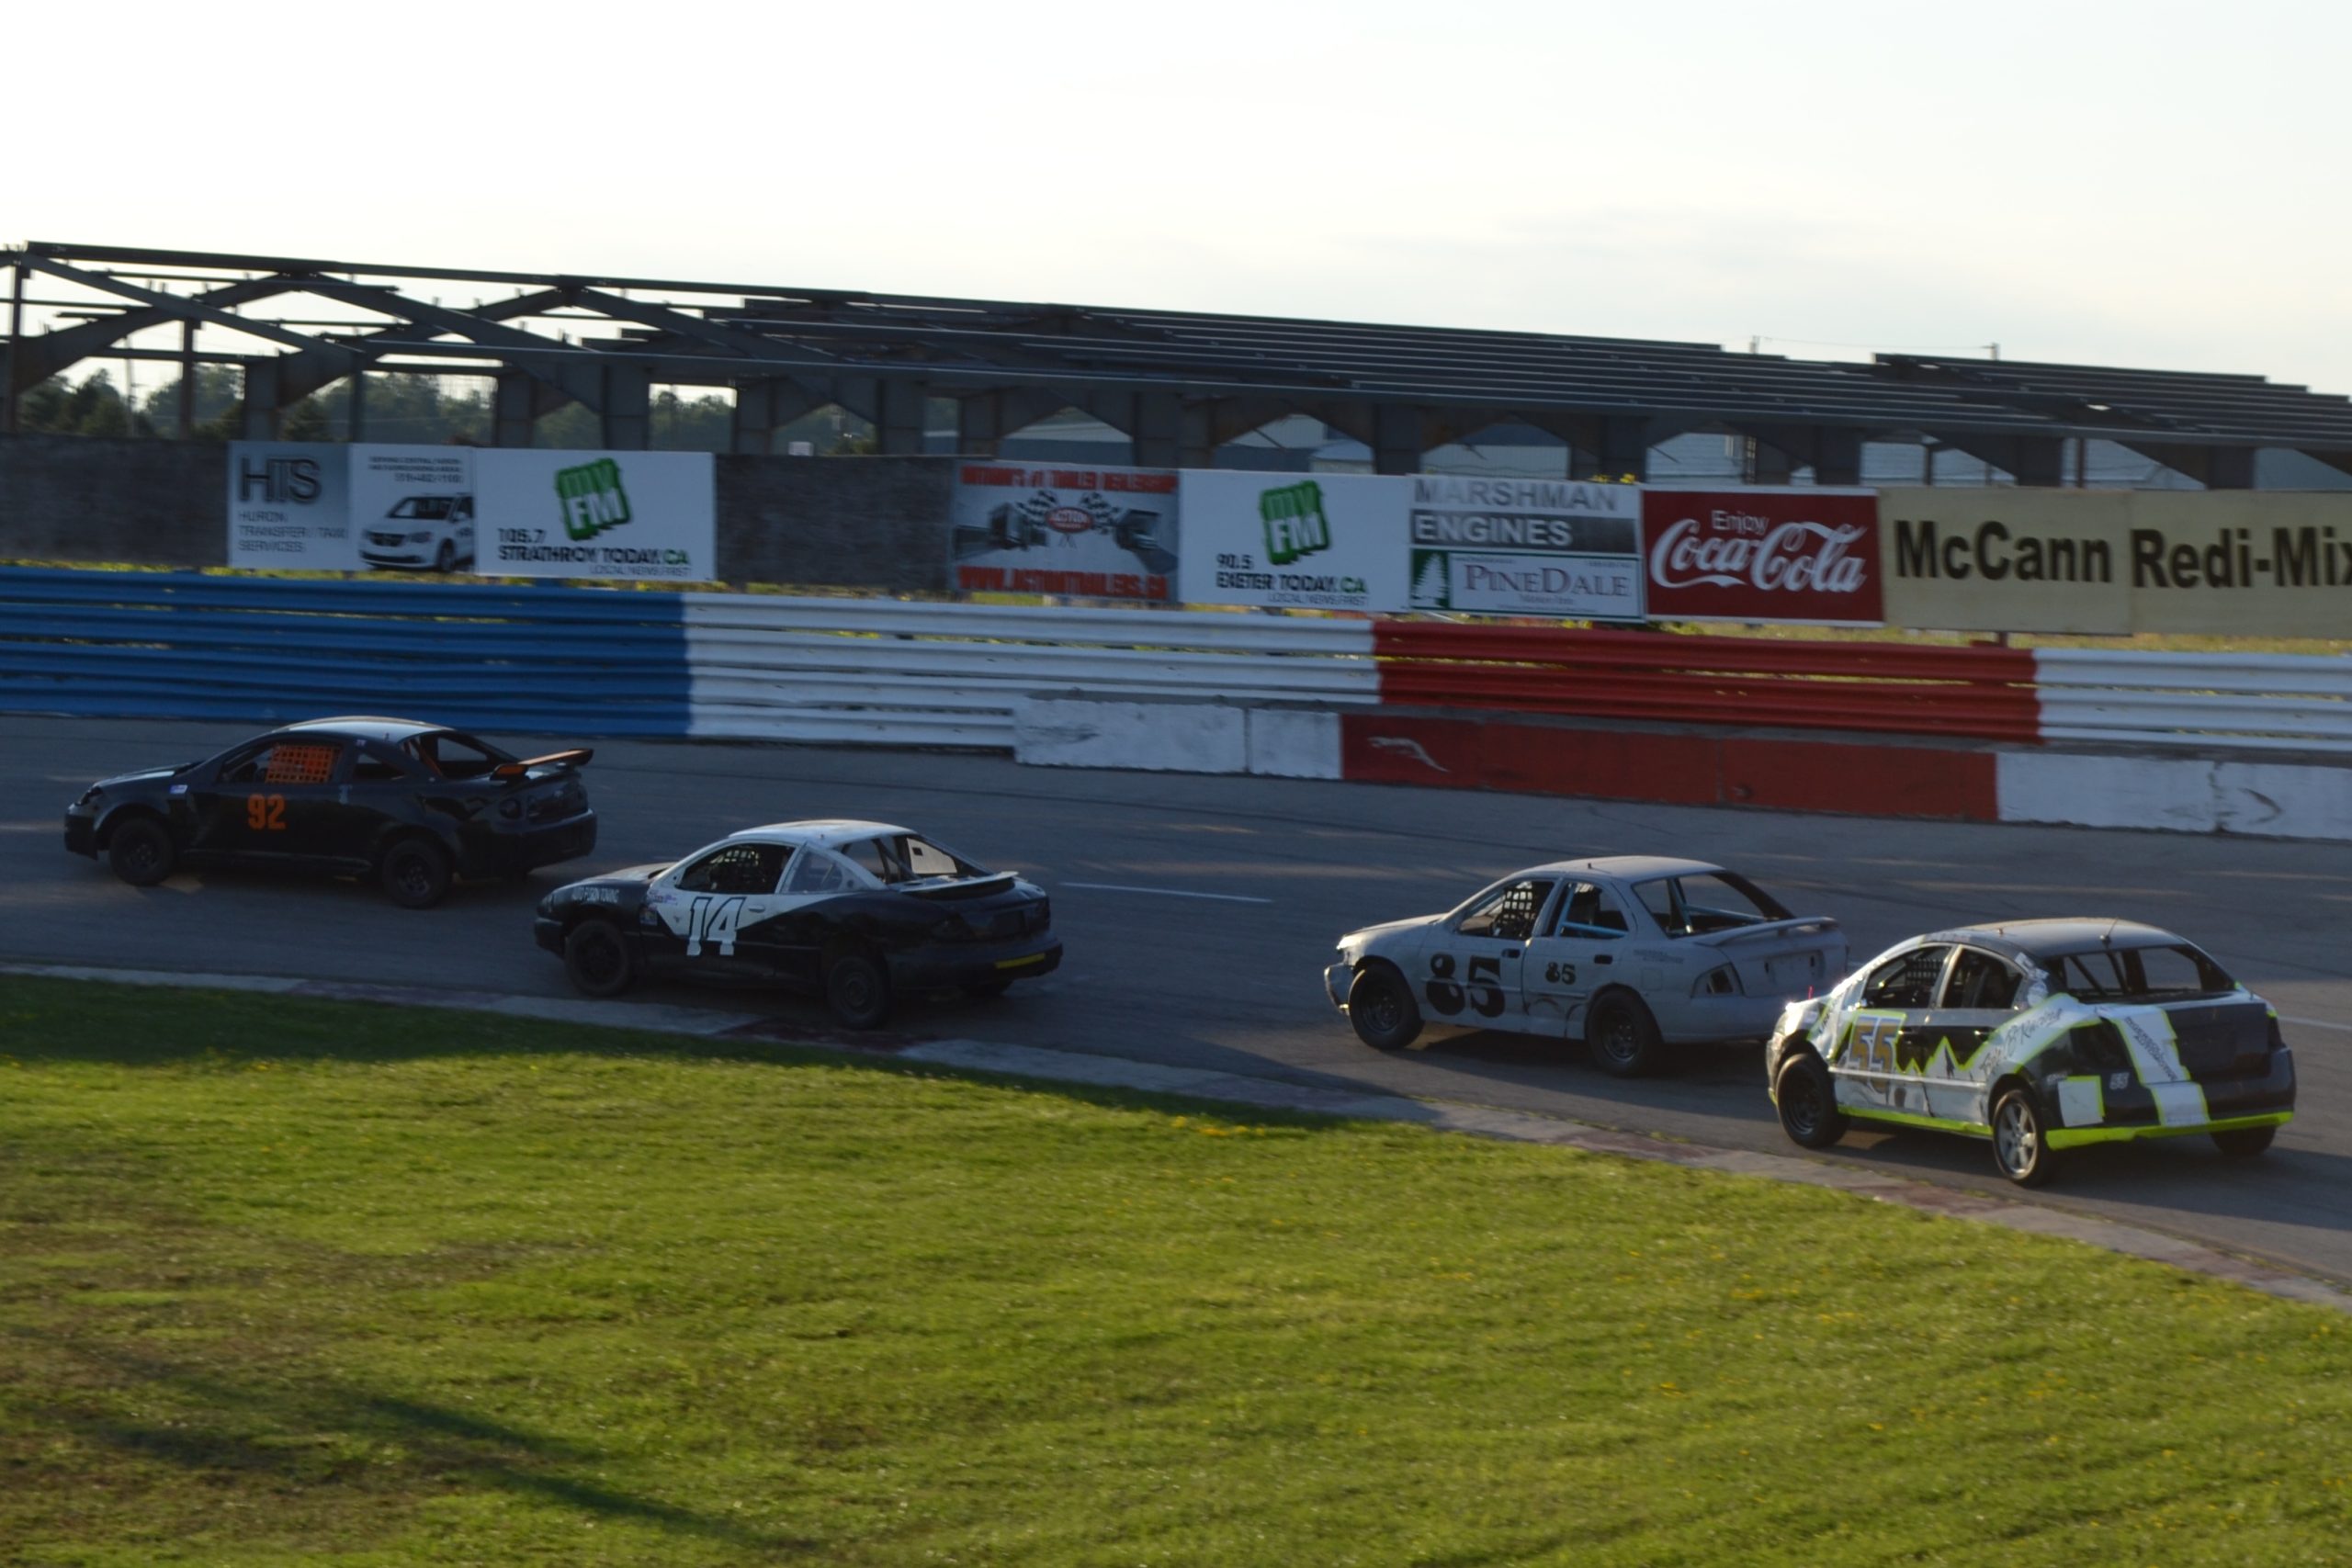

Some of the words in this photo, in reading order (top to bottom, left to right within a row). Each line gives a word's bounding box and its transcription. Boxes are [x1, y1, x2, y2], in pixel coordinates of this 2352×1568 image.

[565, 487, 626, 530] FM
[1415, 478, 1617, 512] MARSHMAN
[1270, 512, 1326, 554] FM
[1415, 514, 1574, 547] ENGINES
[1711, 509, 1770, 536] Enjoy
[1650, 517, 1869, 593] Coca-Cola
[1894, 520, 2112, 582] McCann
[246, 794, 287, 830] 92
[686, 896, 747, 956] 14
[1426, 952, 1506, 1018] 85
[1544, 962, 1577, 985] 85
[1848, 1015, 1903, 1094] 55
